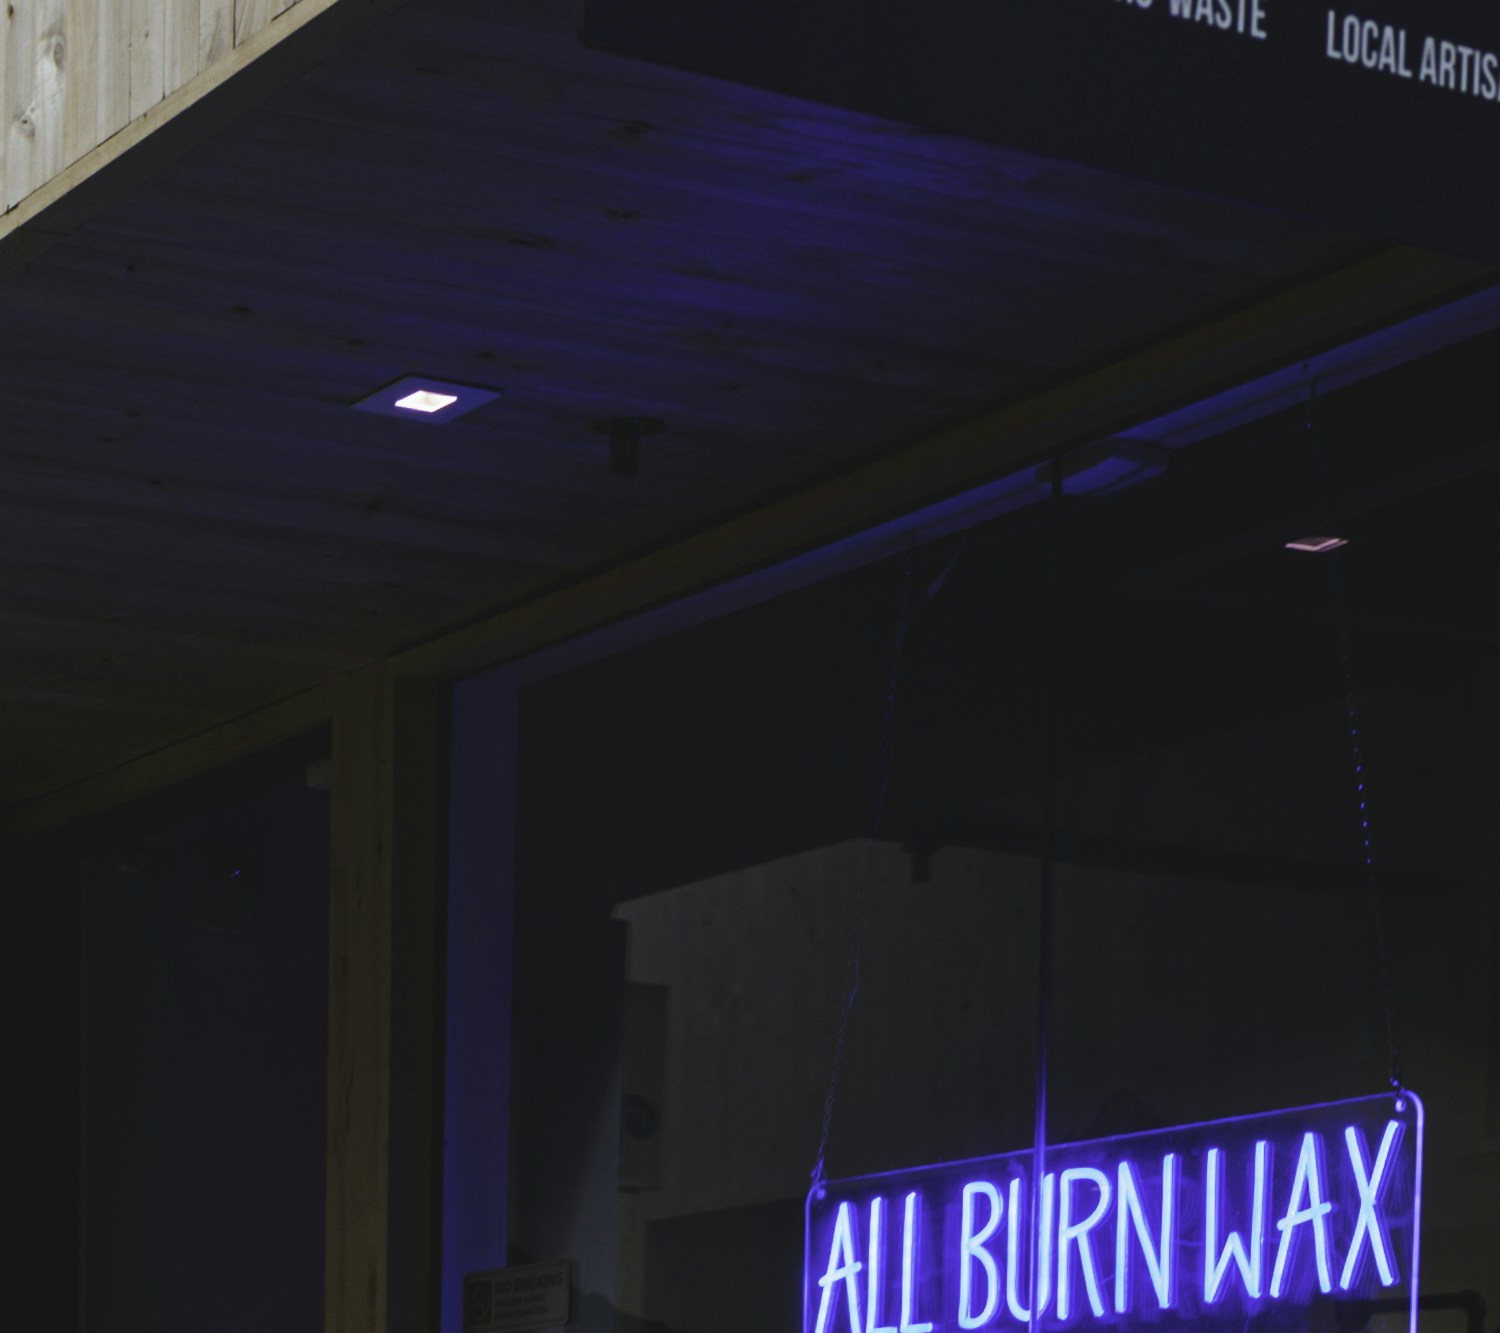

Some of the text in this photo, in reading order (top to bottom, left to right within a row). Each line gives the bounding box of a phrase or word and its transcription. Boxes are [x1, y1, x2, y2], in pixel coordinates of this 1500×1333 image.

[1325, 10, 1413, 79] LOCAL
[957, 1151, 1179, 1331] BURN
[1202, 1118, 1403, 1305] WAX
